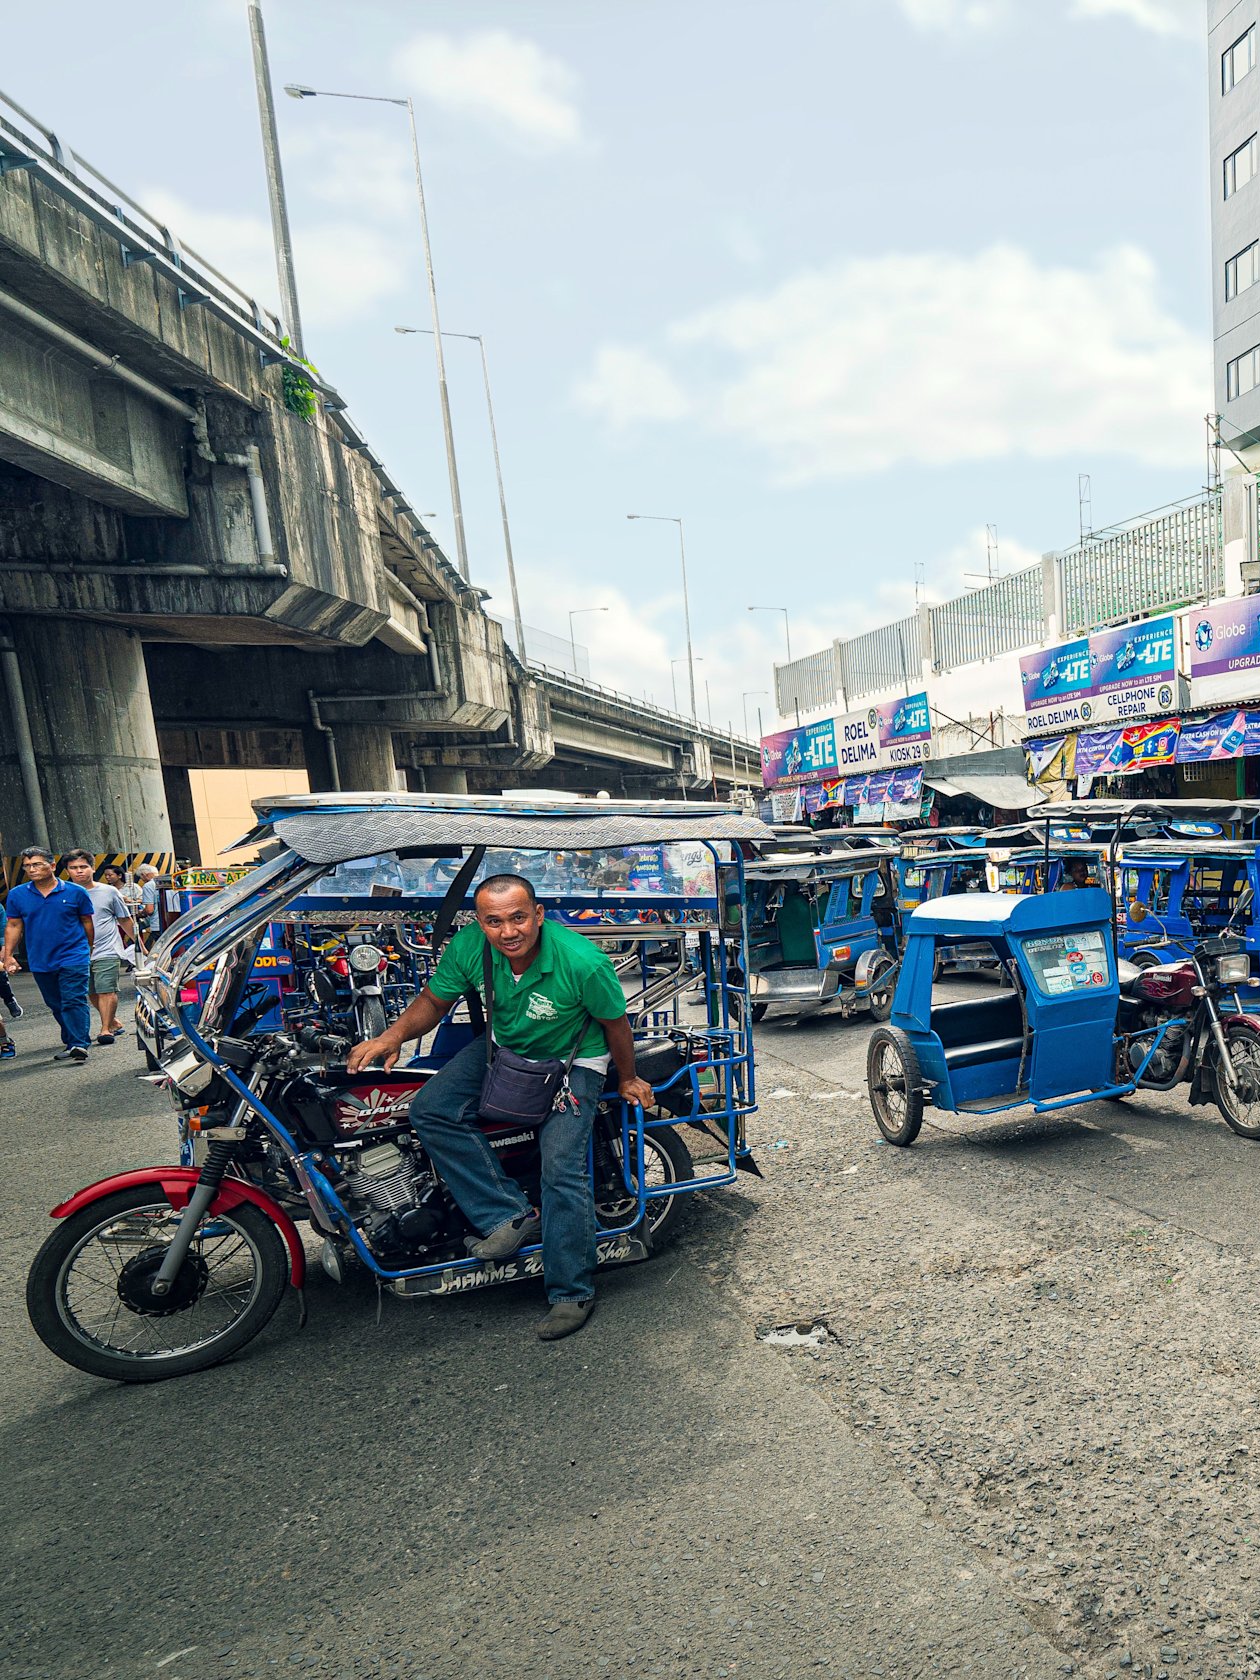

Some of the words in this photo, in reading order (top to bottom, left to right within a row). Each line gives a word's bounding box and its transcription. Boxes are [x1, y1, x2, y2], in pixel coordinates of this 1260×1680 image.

[1134, 628, 1173, 644] EXPERIENCE
[1215, 622, 1246, 640] Globe
[1057, 649, 1089, 664] EXPERIENCE
[1099, 654, 1114, 663] Globe
[1141, 639, 1173, 664] LTE
[1064, 658, 1089, 682] LTE
[1099, 683, 1121, 693] UPGRADE
[1121, 680, 1134, 688] NOW
[1144, 675, 1153, 684] LTE
[1153, 673, 1162, 682] SIM
[1107, 687, 1156, 706] CELLPHONE
[1161, 689, 1170, 704] BS
[909, 708, 927, 728] LTE
[1118, 702, 1147, 717] REPAIR
[1027, 715, 1048, 730] ROEL
[1048, 708, 1080, 725] DELIMA
[1245, 721, 1260, 730] EXTRA
[844, 721, 869, 742] ROEL
[808, 733, 834, 767] LTE
[841, 742, 878, 764] DELIMA
[889, 746, 912, 762] KIOSK
[911, 745, 921, 759] 29
[182, 873, 218, 886] ZYRA
[358, 1101, 410, 1118] BARA
[489, 1131, 535, 1148] awasaki
[596, 1242, 633, 1265] Shop
